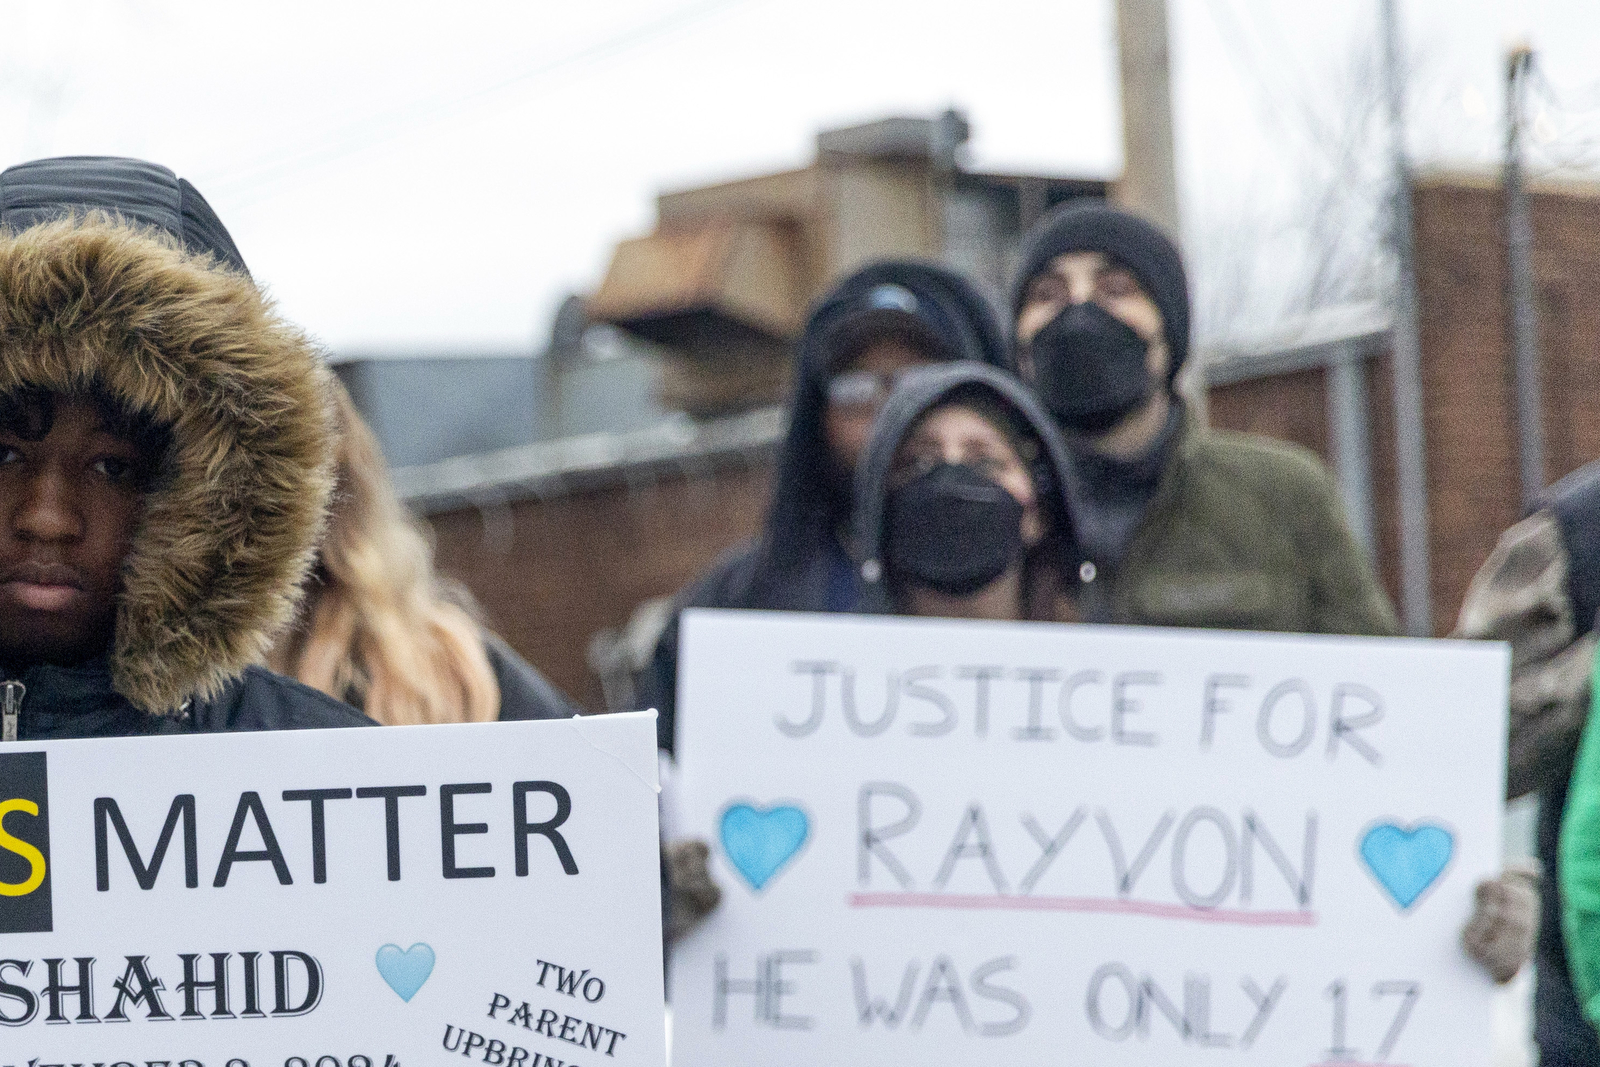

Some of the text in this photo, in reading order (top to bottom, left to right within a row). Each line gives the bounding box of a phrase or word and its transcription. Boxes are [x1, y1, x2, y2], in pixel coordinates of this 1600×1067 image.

[774, 660, 1386, 766] JUSTICE FOR
[93, 780, 580, 892] MATTER
[855, 781, 1318, 910] RAYVON
[487, 992, 627, 1057] PARENT
[536, 959, 605, 1003] TWO
[712, 949, 1422, 1063] HE WAS ONLY 17
